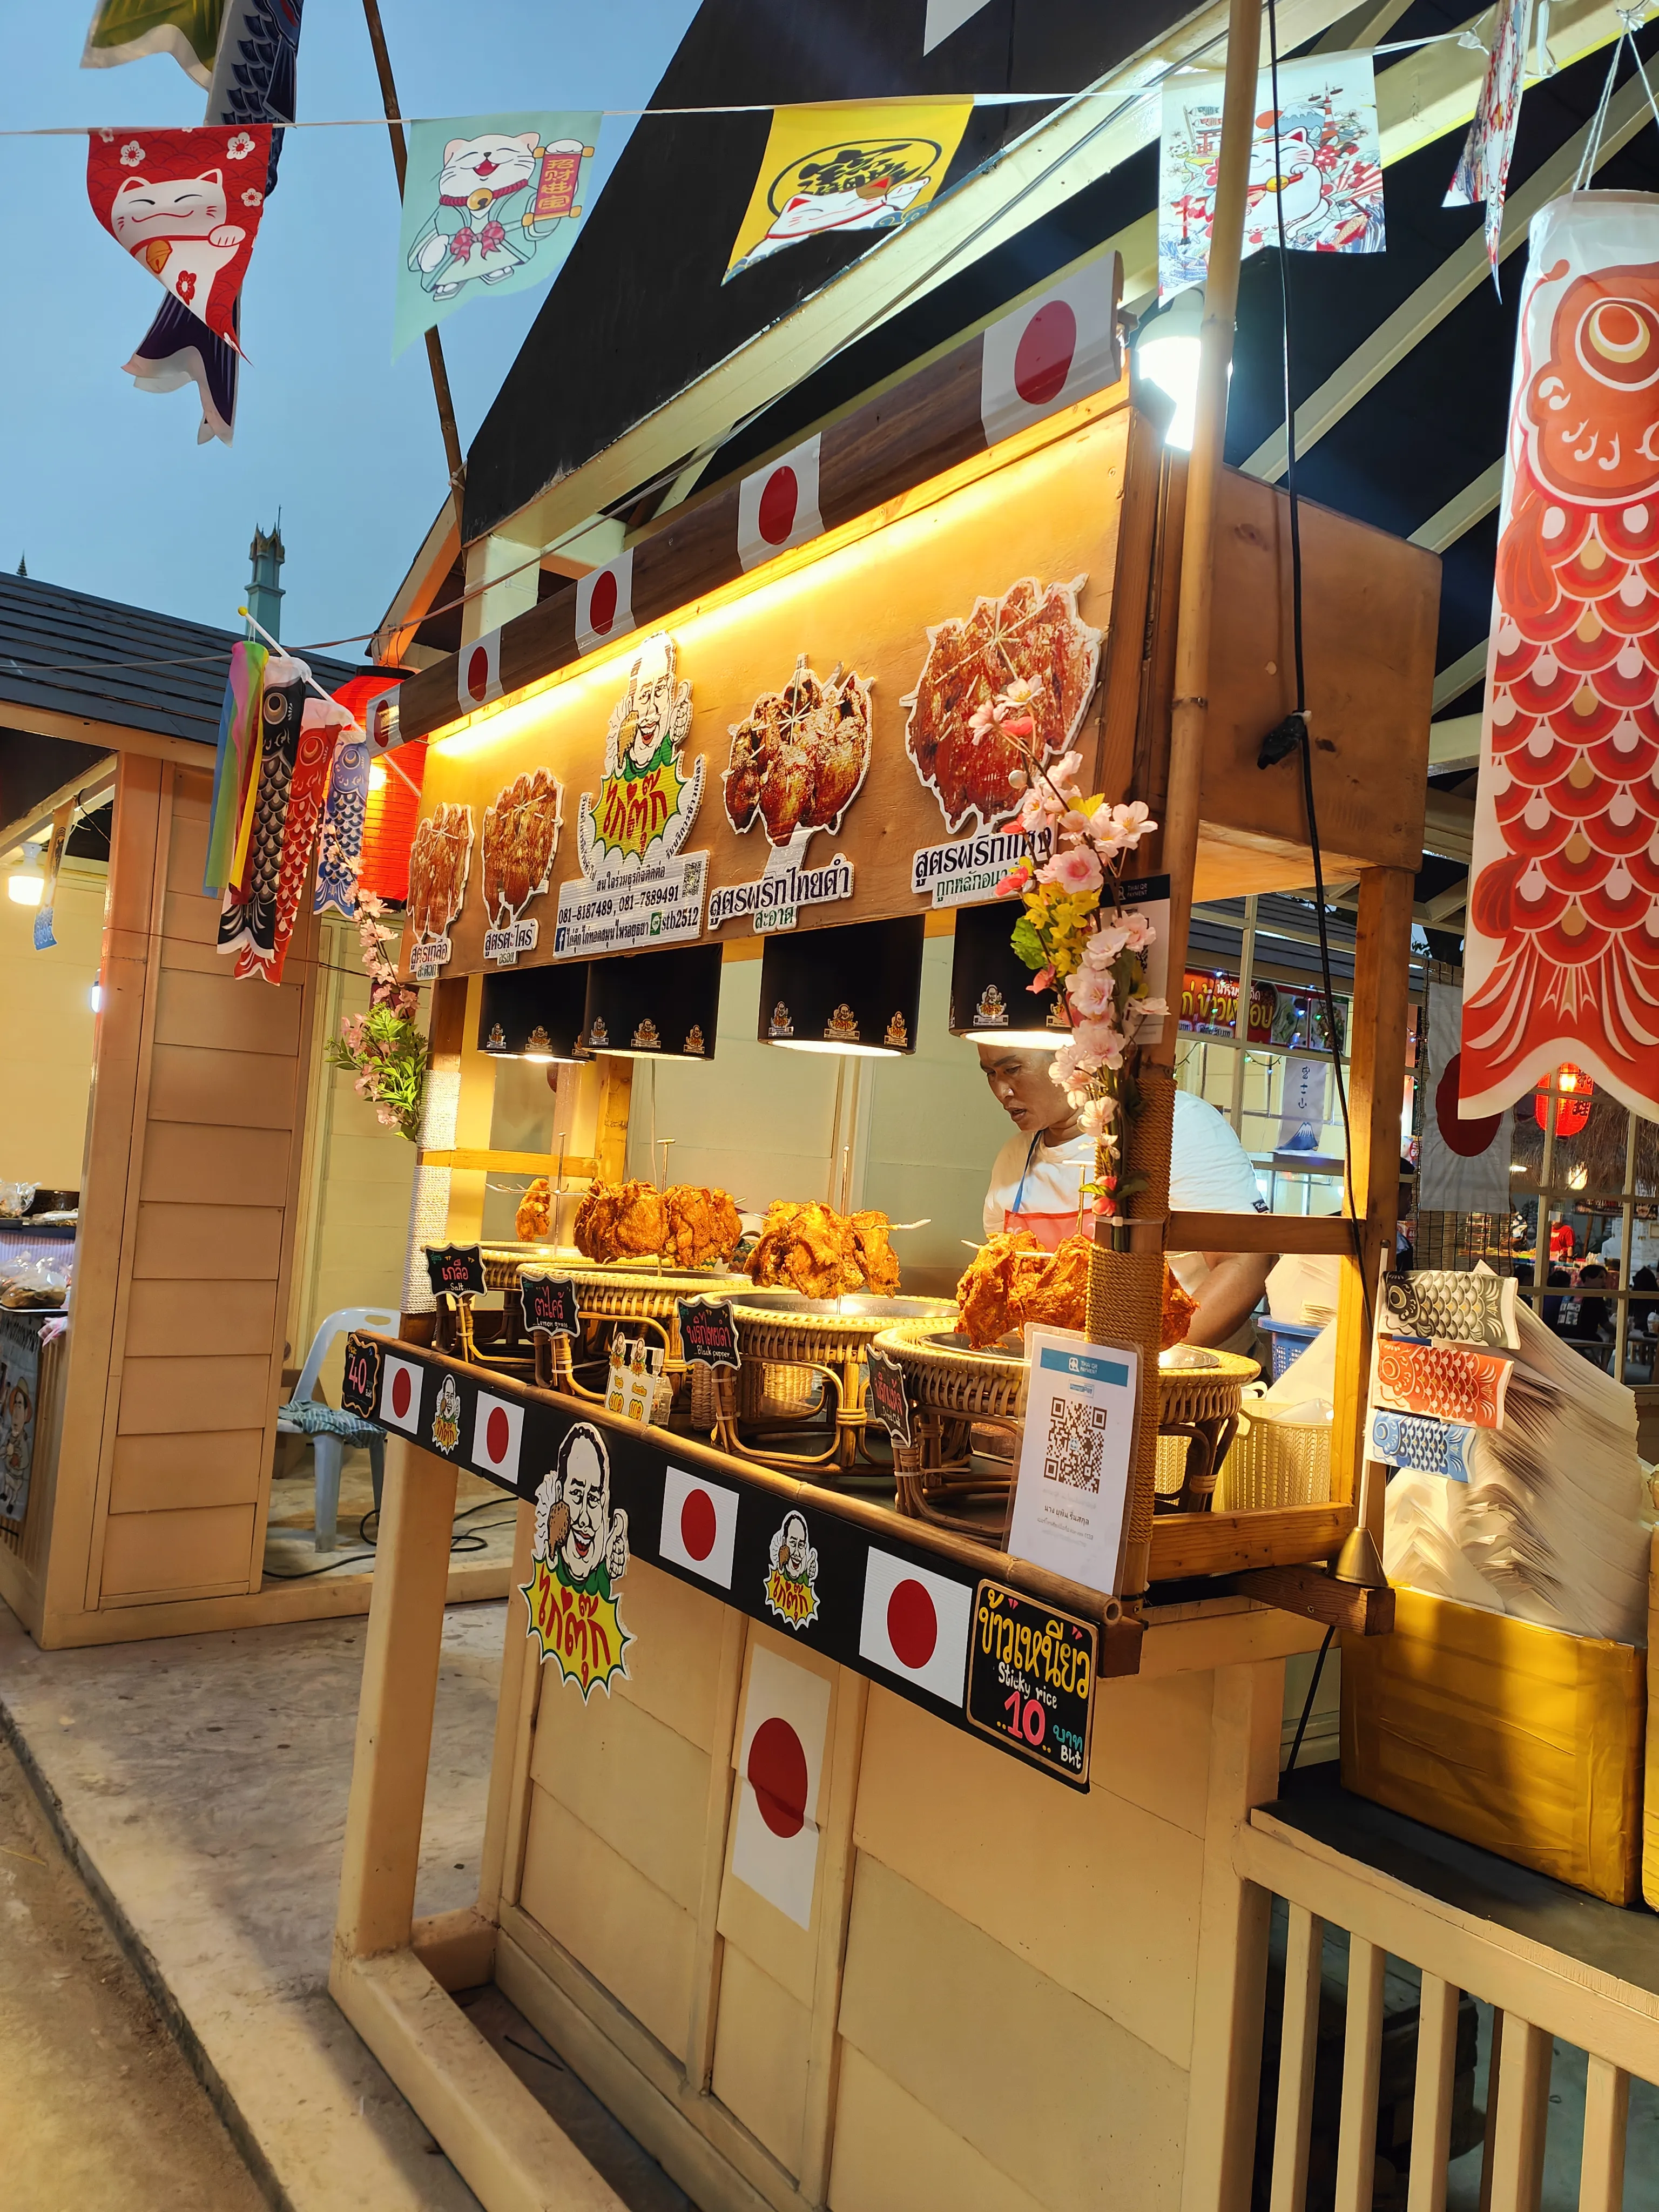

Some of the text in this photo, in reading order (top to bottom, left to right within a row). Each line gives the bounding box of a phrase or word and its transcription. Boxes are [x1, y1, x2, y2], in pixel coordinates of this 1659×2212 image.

[710, 859, 849, 926] สูตรพริกไทยดำ
[662, 907, 699, 931] stb2512
[755, 906, 794, 929] สะอาด
[410, 939, 448, 969] สูตรเกลือ
[484, 923, 535, 956] สูตรตะไคร้
[442, 1259, 468, 1280] เกลือ
[535, 1286, 565, 1319] ตะไคร้
[348, 1356, 367, 1394] 40
[979, 1589, 1090, 1699] ข้าวเหนียว
[998, 1662, 1057, 1709] Sticky rice
[1053, 1724, 1083, 1752] บาท
[1061, 1745, 1082, 1769] Bht
